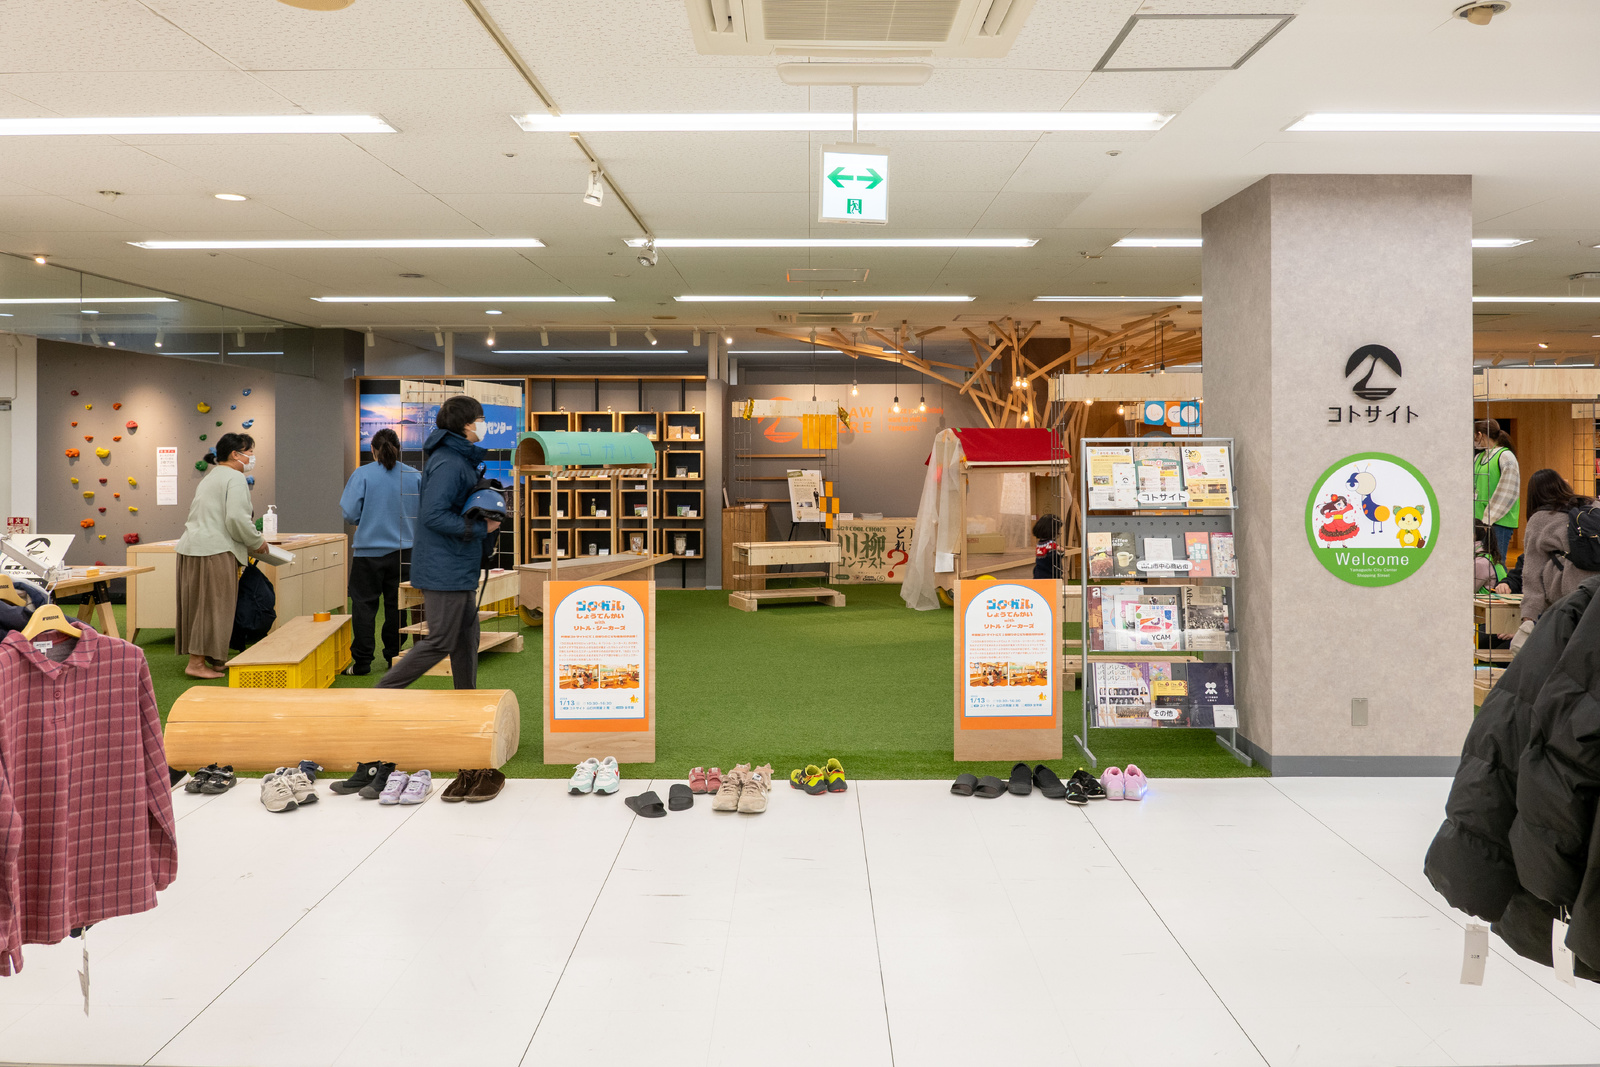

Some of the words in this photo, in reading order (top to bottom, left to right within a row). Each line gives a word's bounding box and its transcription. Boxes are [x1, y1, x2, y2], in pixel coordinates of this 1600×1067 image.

[848, 406, 874, 418] AW
[1328, 405, 1419, 424] コトサイト
[486, 421, 513, 435] センター
[839, 421, 872, 434] ERE
[557, 442, 636, 460] コロガル
[1142, 493, 1185, 501] コトサイト
[837, 532, 887, 559] 川柳
[837, 556, 886, 570] コンテスト
[1335, 552, 1409, 566] Welcome
[1153, 709, 1174, 718] その他
